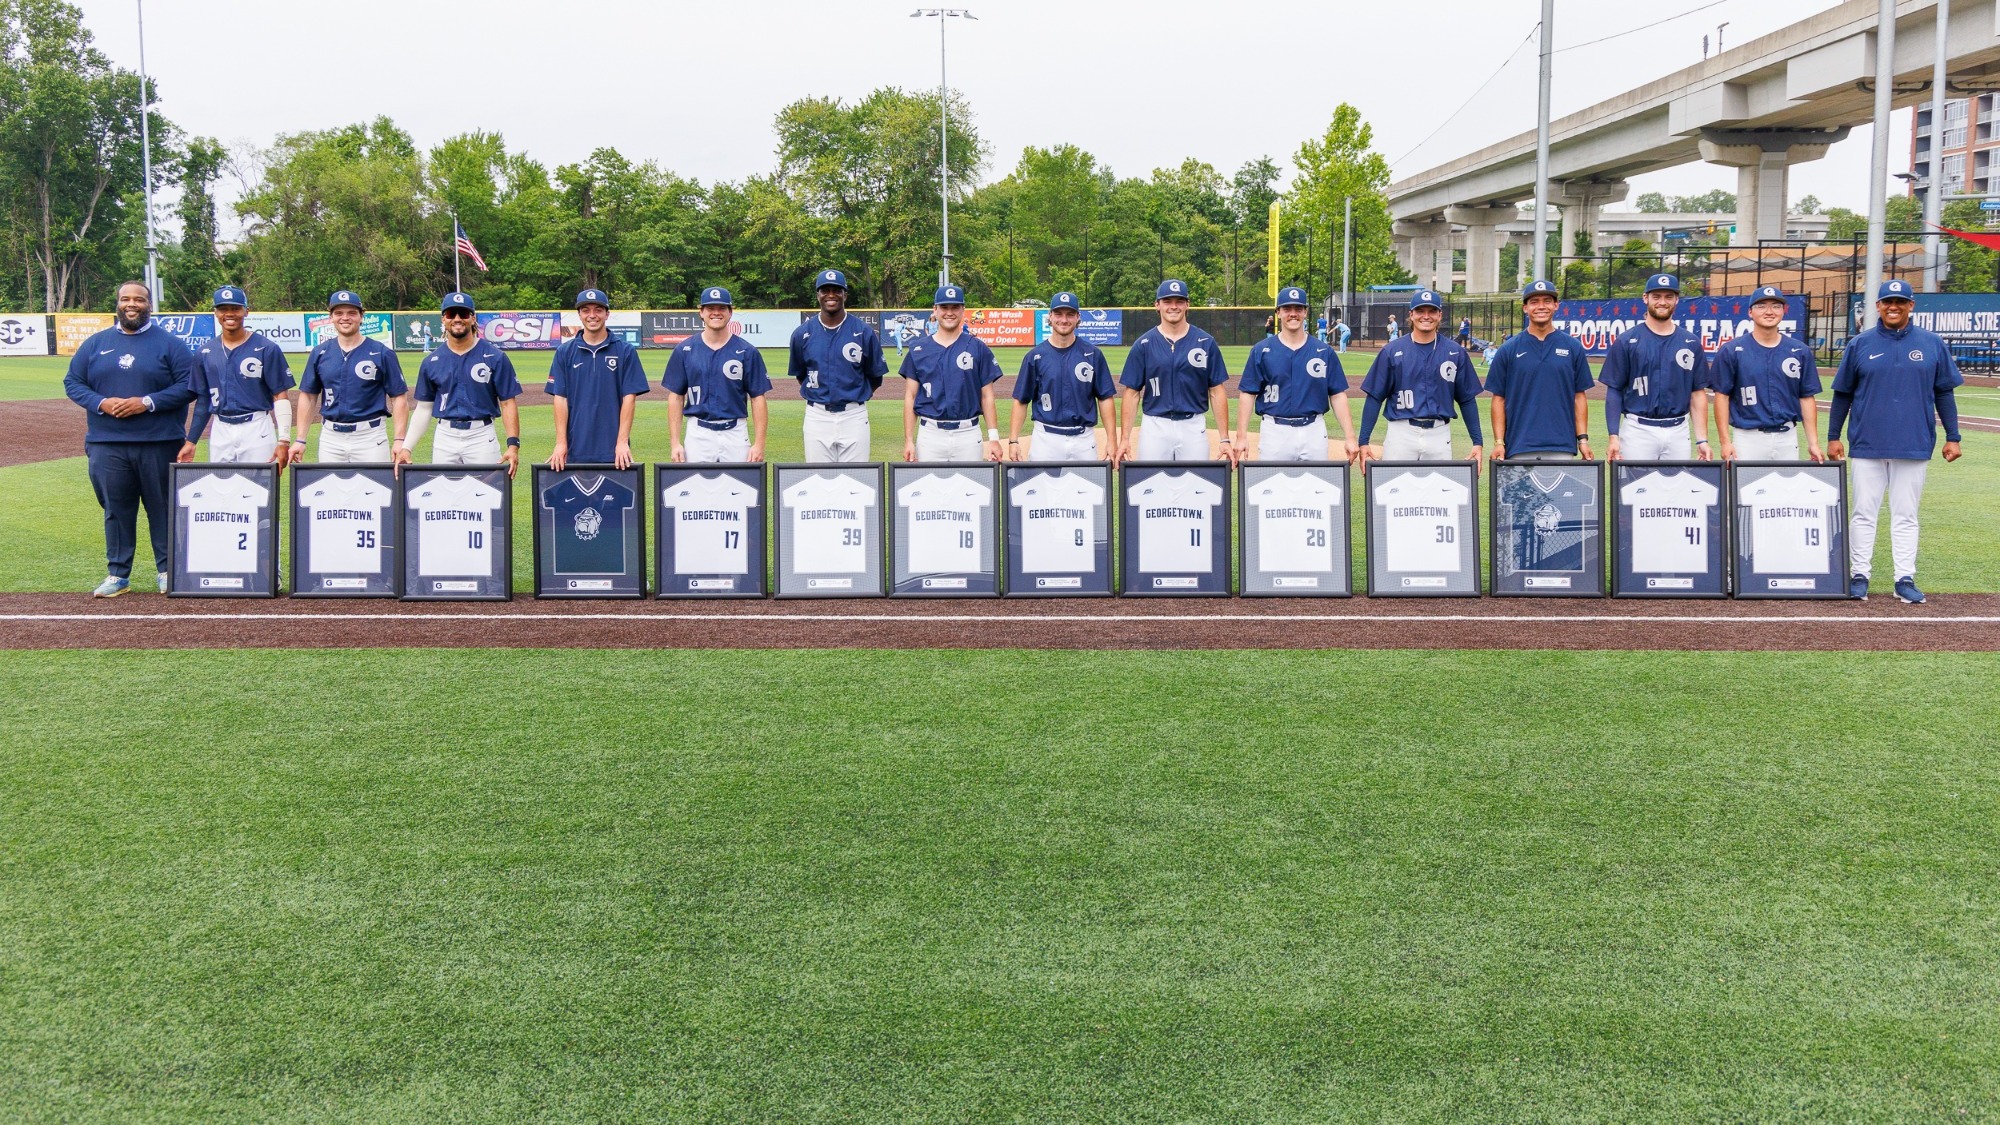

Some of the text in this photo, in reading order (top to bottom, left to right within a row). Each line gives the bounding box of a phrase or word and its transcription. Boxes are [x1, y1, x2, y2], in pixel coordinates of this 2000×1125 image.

[484, 318, 554, 342] CSI
[742, 324, 762, 334] JLL
[998, 326, 1032, 334] Corner
[1936, 312, 1972, 332] INNING
[1974, 312, 2000, 332] STRE
[1632, 376, 1648, 396] 41
[1041, 394, 1052, 412] 8
[1396, 390, 1414, 410] 30
[1740, 386, 1757, 406] 19
[194, 512, 249, 523] GEORGETOWN
[316, 509, 372, 521] GEORGETOWN
[425, 510, 482, 522] GEORGETOWN
[682, 510, 739, 522] GEORGETOWN
[800, 509, 856, 520] GEORGETOWN
[915, 510, 971, 522] GEORGETOWN
[1029, 508, 1085, 519] GEORGETOWN
[1145, 507, 1202, 519] GEORGETOWN
[1265, 507, 1322, 520] GEORGETOWN
[1393, 506, 1448, 518] GEORGETOWN
[1640, 508, 1696, 519] GEORGETOWN
[1759, 508, 1818, 519] GEORGETOWN
[239, 533, 246, 550] 2
[357, 530, 374, 548] 35
[469, 531, 482, 549] 10
[726, 531, 738, 549] 17
[843, 528, 861, 545] 39
[960, 531, 973, 548] 18
[1075, 529, 1083, 546] 8
[1191, 529, 1200, 546] 11
[1307, 529, 1325, 547] 28
[1436, 526, 1454, 543] 30
[1686, 527, 1700, 544] 41
[1805, 528, 1819, 546] 19
